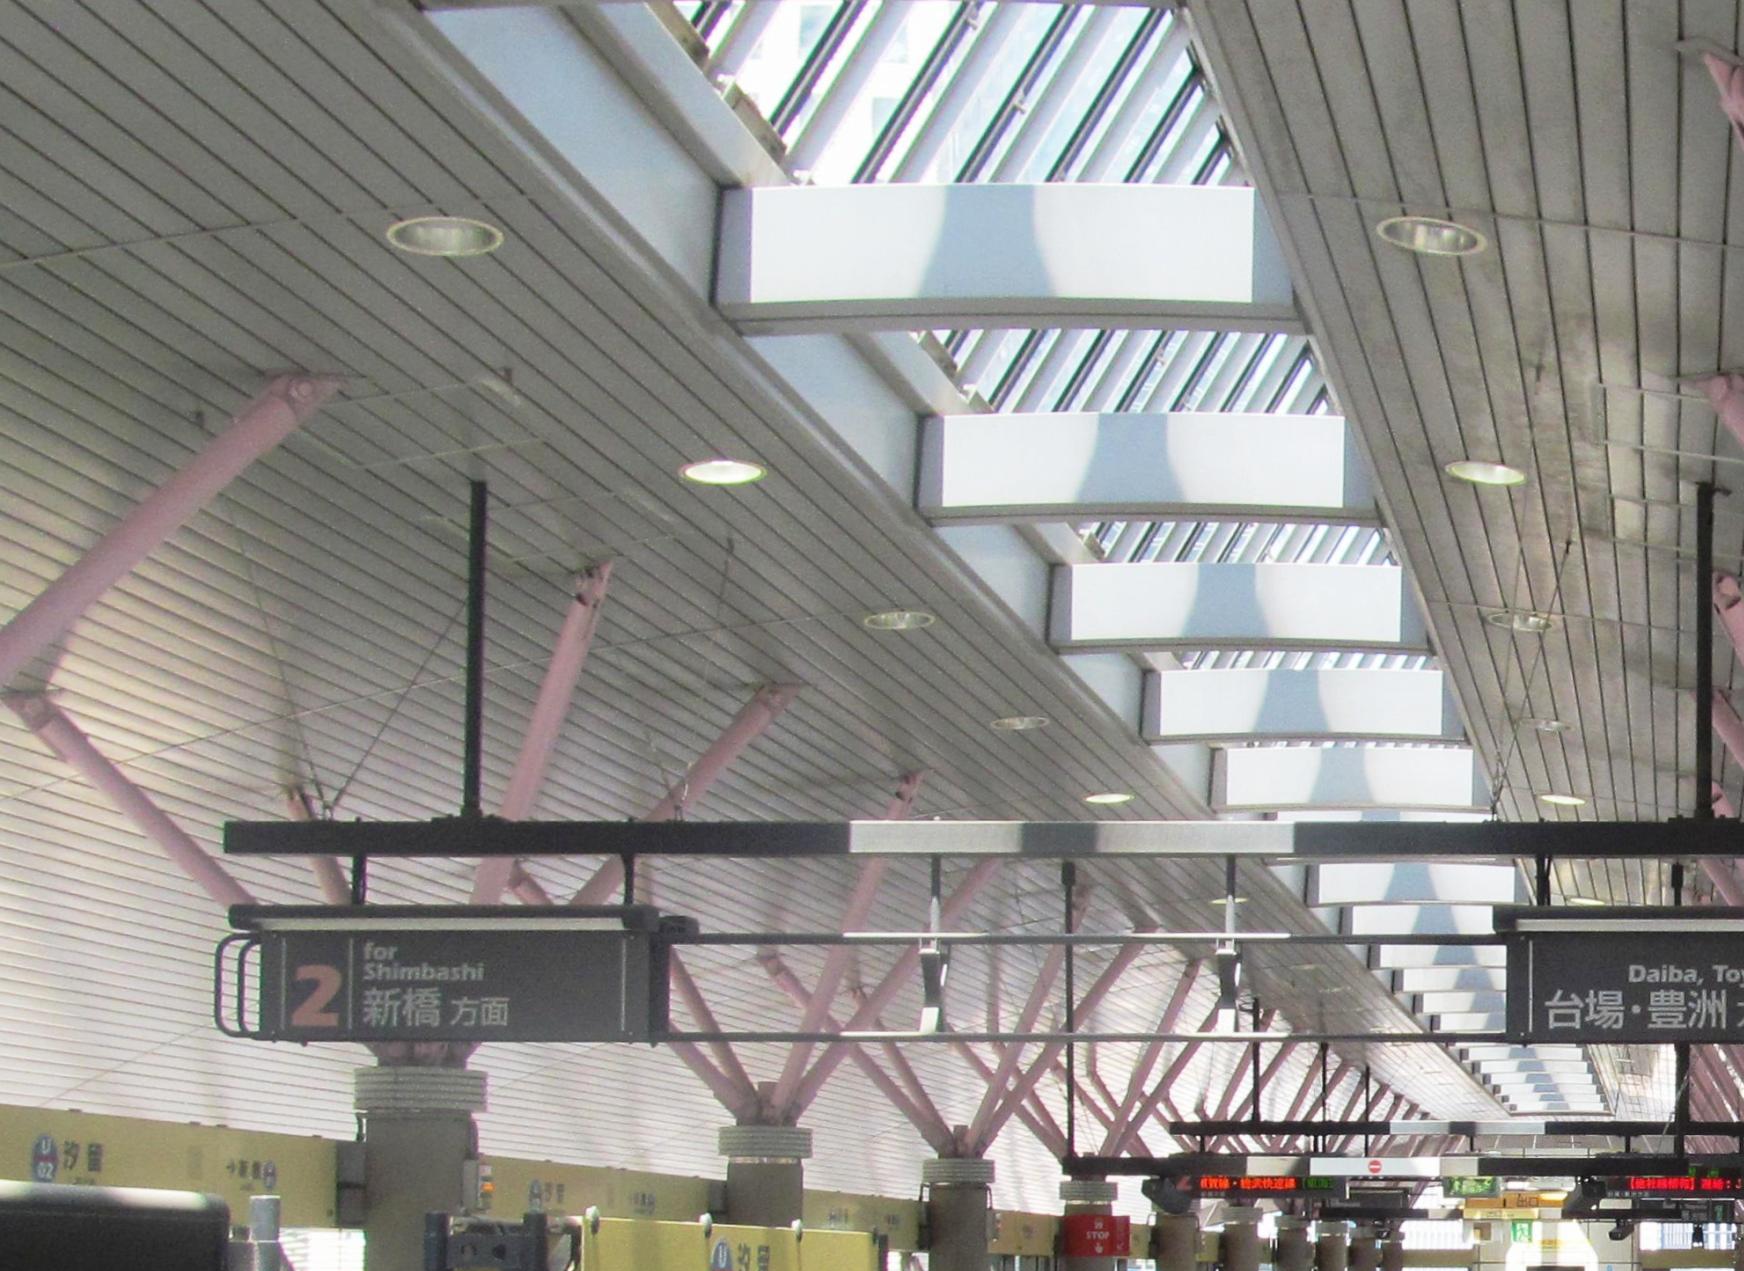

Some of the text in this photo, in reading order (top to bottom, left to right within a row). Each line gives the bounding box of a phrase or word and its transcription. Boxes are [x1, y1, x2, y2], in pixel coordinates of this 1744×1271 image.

[363, 943, 397, 961] for
[362, 962, 485, 982] Shimbashi
[1629, 965, 1703, 986] Daiba,
[291, 964, 342, 1028] 2
[363, 987, 510, 1029] 新橋 方面
[1086, 1231, 1110, 1240] STOP
